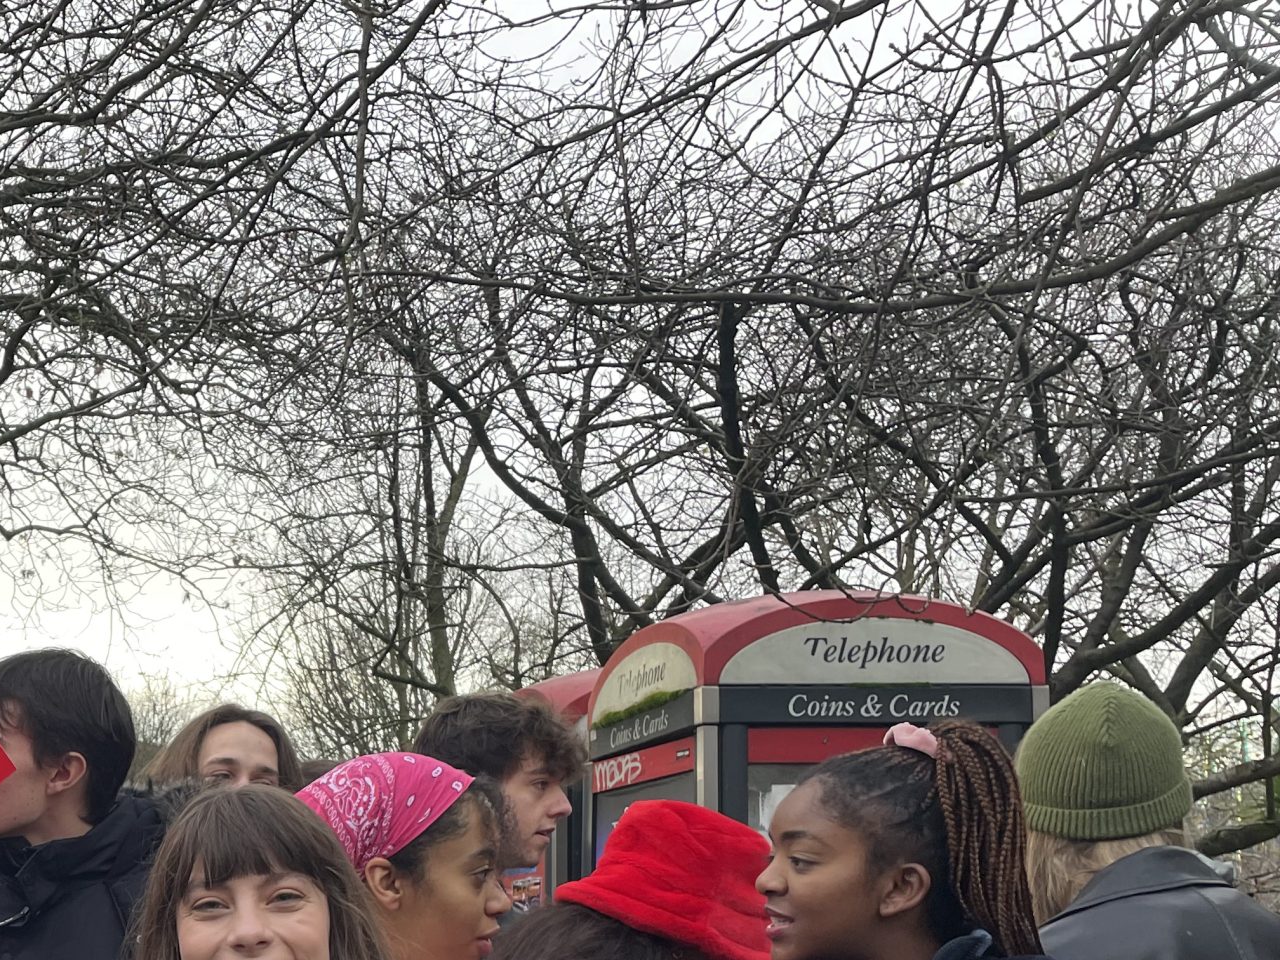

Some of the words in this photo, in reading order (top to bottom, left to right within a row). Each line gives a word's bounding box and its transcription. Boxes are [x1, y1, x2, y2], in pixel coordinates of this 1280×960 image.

[803, 637, 945, 669] Telephone
[618, 662, 666, 697] Telephone
[788, 694, 855, 717] Coins
[860, 694, 882, 717] &
[889, 694, 960, 717] Cards
[610, 725, 632, 749] Coins
[632, 718, 641, 741] &
[642, 709, 669, 736] Cards
